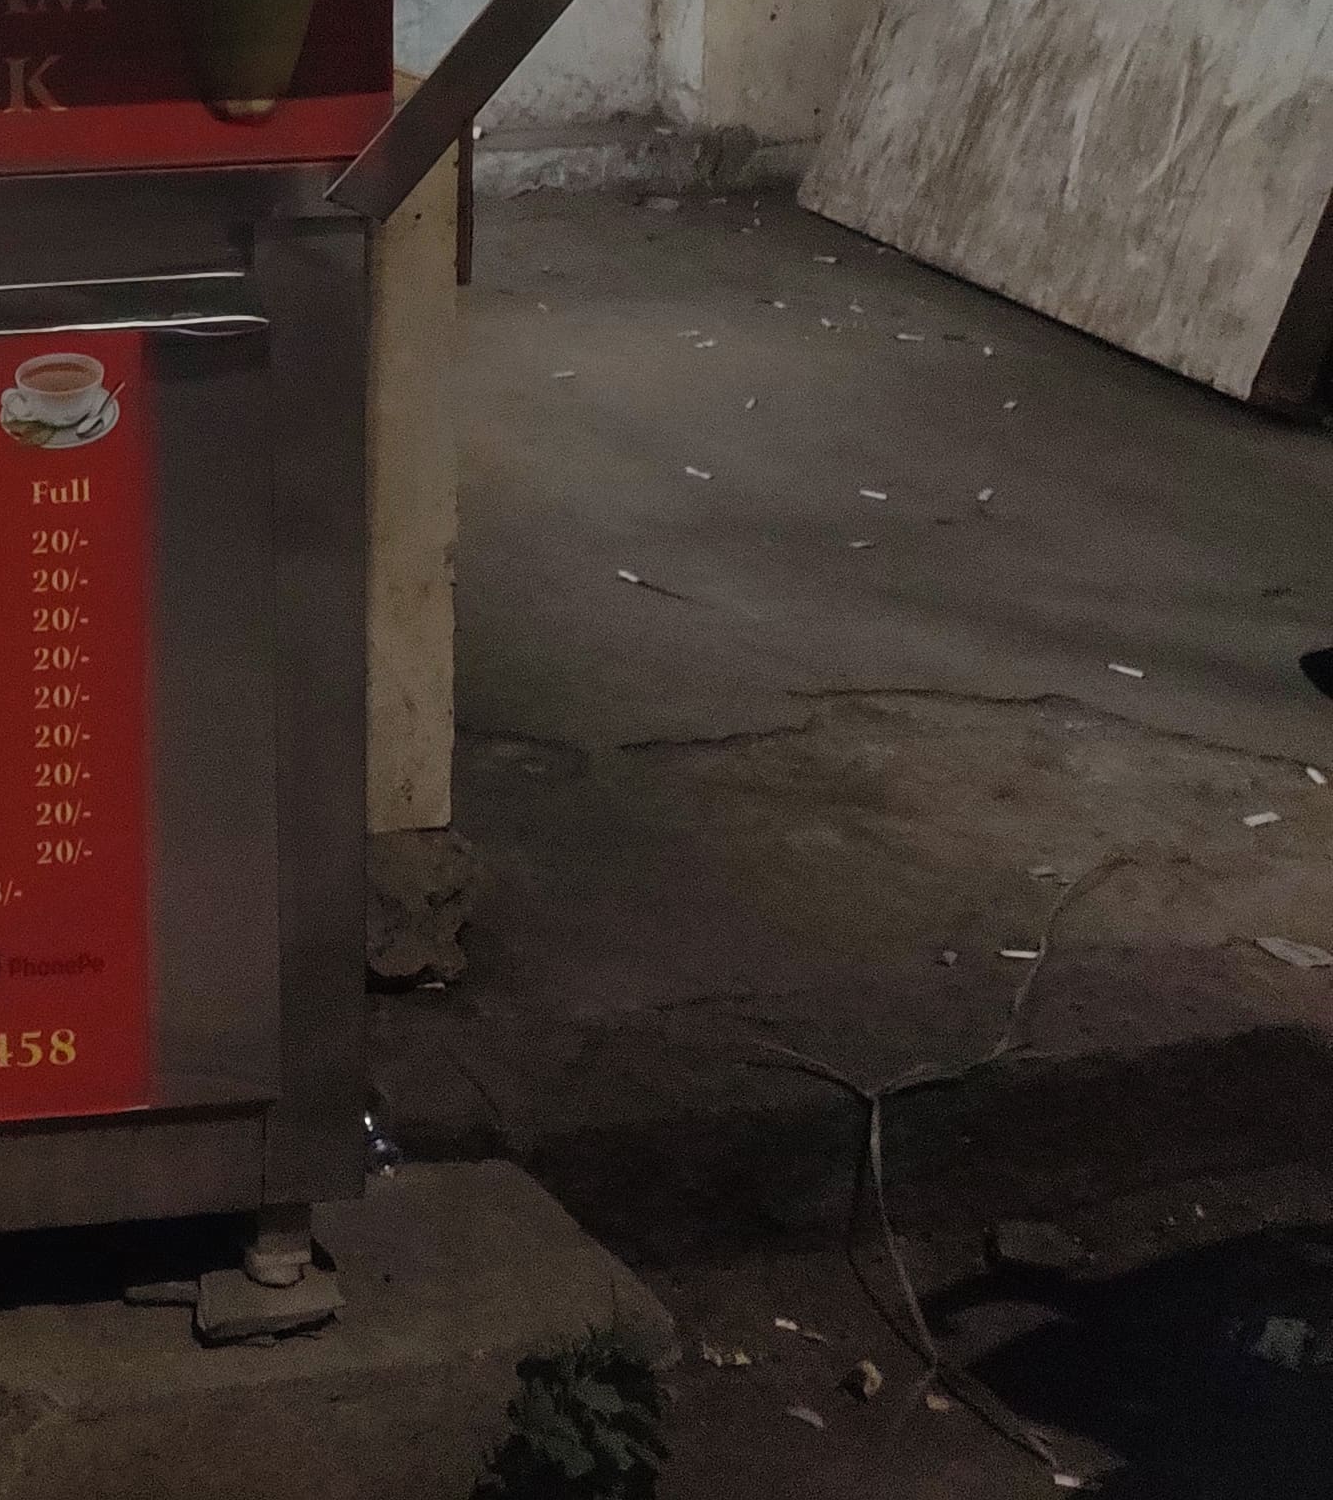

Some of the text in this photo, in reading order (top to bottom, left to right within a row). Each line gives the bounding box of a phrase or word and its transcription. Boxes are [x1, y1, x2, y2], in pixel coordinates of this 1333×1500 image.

[32, 478, 91, 505] Full
[33, 529, 89, 555] 20/-
[33, 568, 89, 594] 20/-
[33, 607, 89, 633] 20/-
[34, 647, 89, 672] 20/-
[34, 685, 90, 710] 20/-
[35, 724, 90, 750] 20/-
[35, 763, 90, 789] 20/-
[36, 802, 91, 827] 20/-
[36, 841, 93, 866] 20/-
